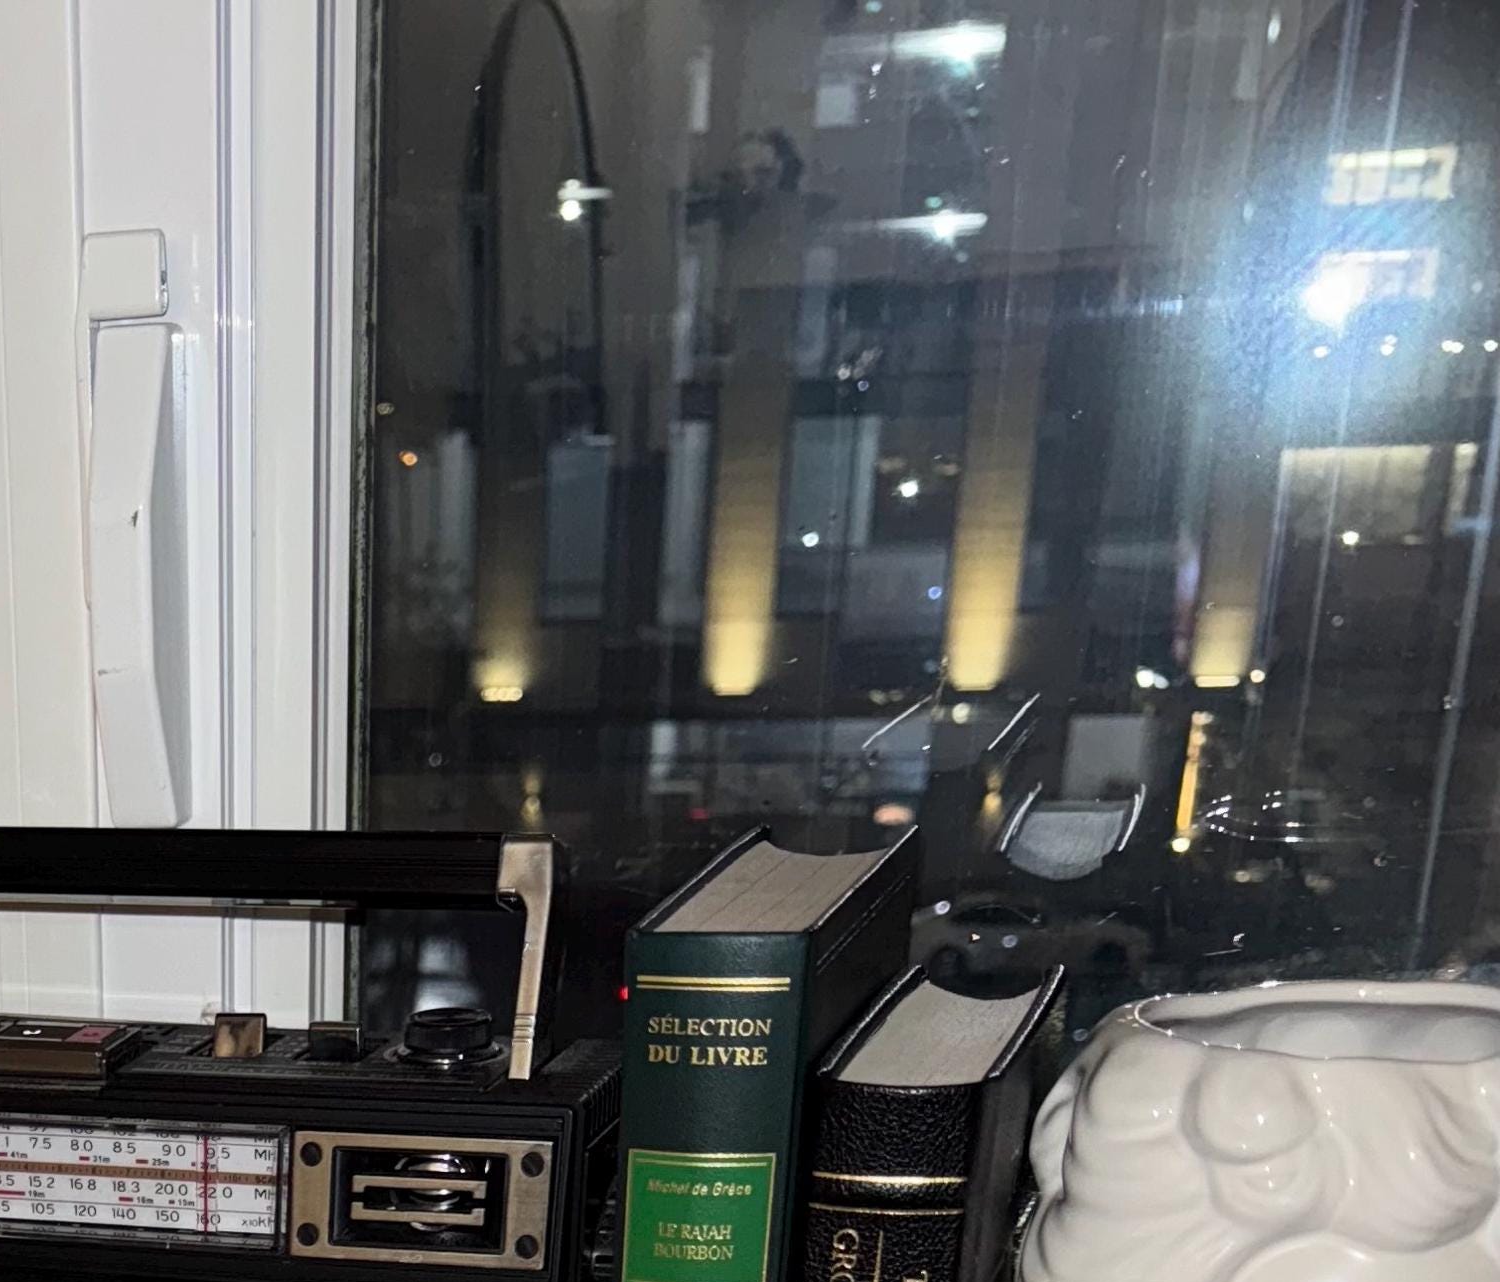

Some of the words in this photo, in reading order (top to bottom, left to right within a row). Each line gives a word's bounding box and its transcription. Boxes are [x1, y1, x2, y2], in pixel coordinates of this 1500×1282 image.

[648, 1014, 772, 1036] SÉLECTION
[648, 1045, 680, 1064] DU
[691, 1046, 767, 1066] LIVRE
[692, 1183, 708, 1196] de
[31, 1202, 55, 1215] 105
[74, 1204, 97, 1217] 120
[112, 1207, 136, 1220] 140
[156, 1210, 180, 1222] 150
[658, 1221, 678, 1239] LE
[681, 1223, 732, 1242] RAJAH
[653, 1243, 735, 1261] BOURBON
